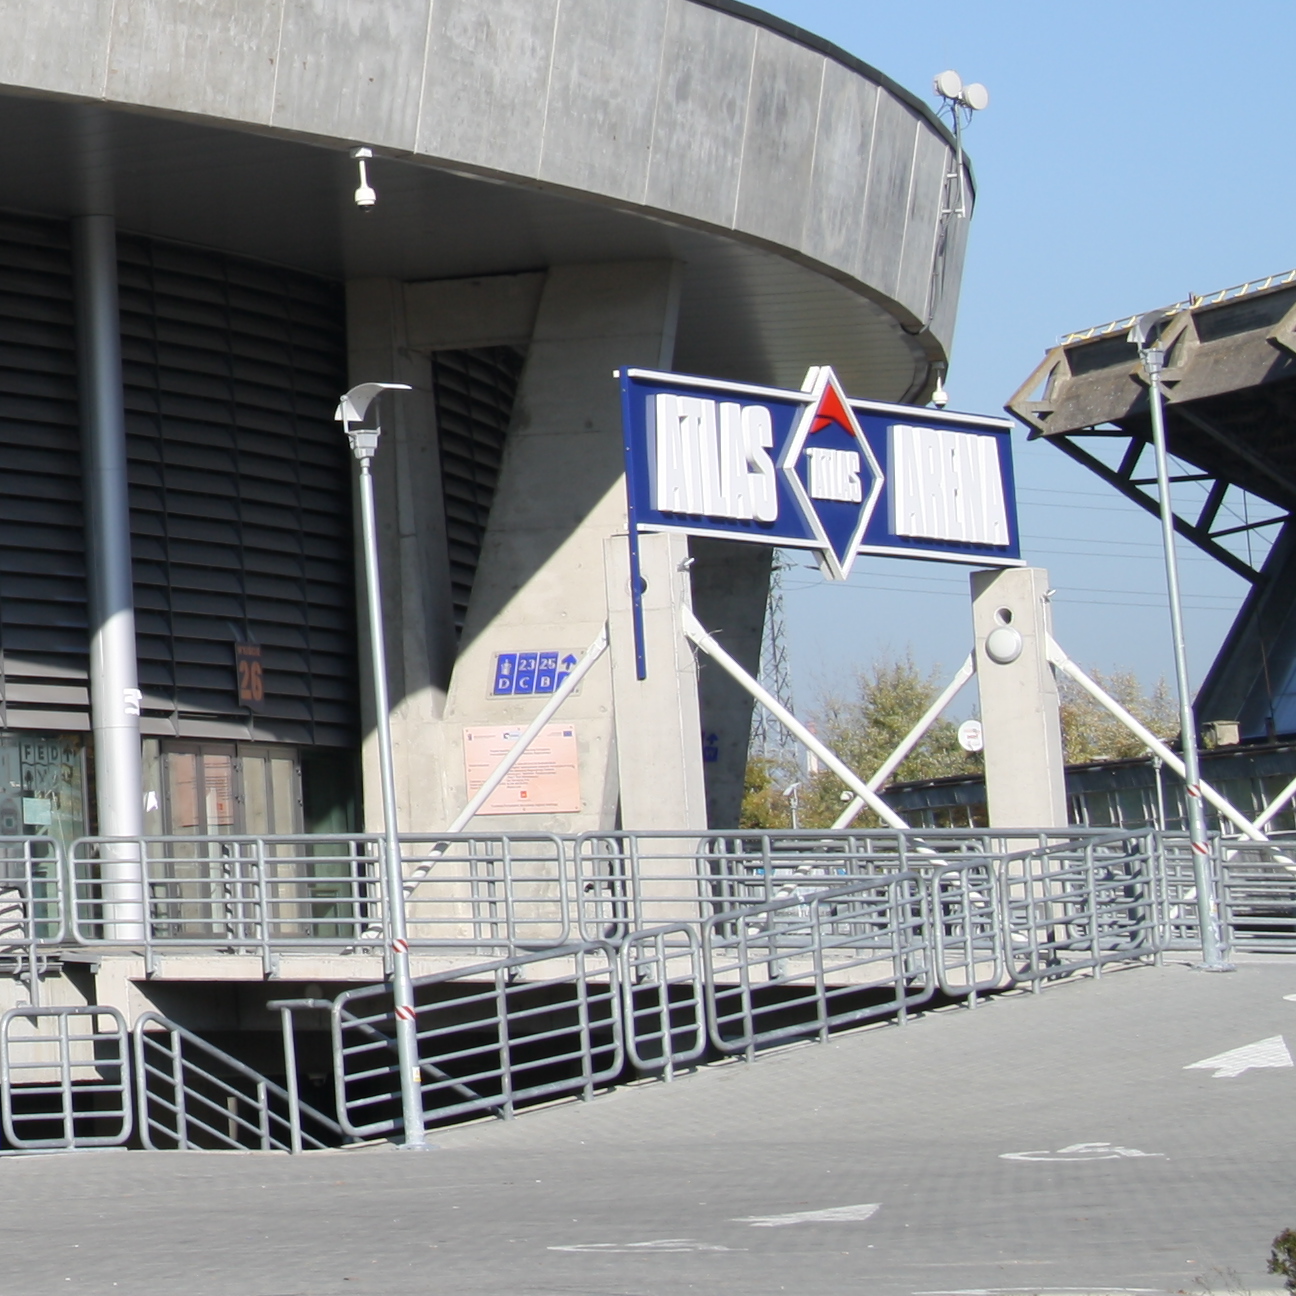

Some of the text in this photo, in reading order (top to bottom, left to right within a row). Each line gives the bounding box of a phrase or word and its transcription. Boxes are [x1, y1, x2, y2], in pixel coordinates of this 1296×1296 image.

[656, 394, 1010, 546] ATLAS ARENA
[810, 448, 862, 503] ATLAS
[518, 658, 557, 671] 23 25
[239, 660, 264, 701] 26
[498, 676, 551, 689] D C B
[38, 745, 45, 760] E
